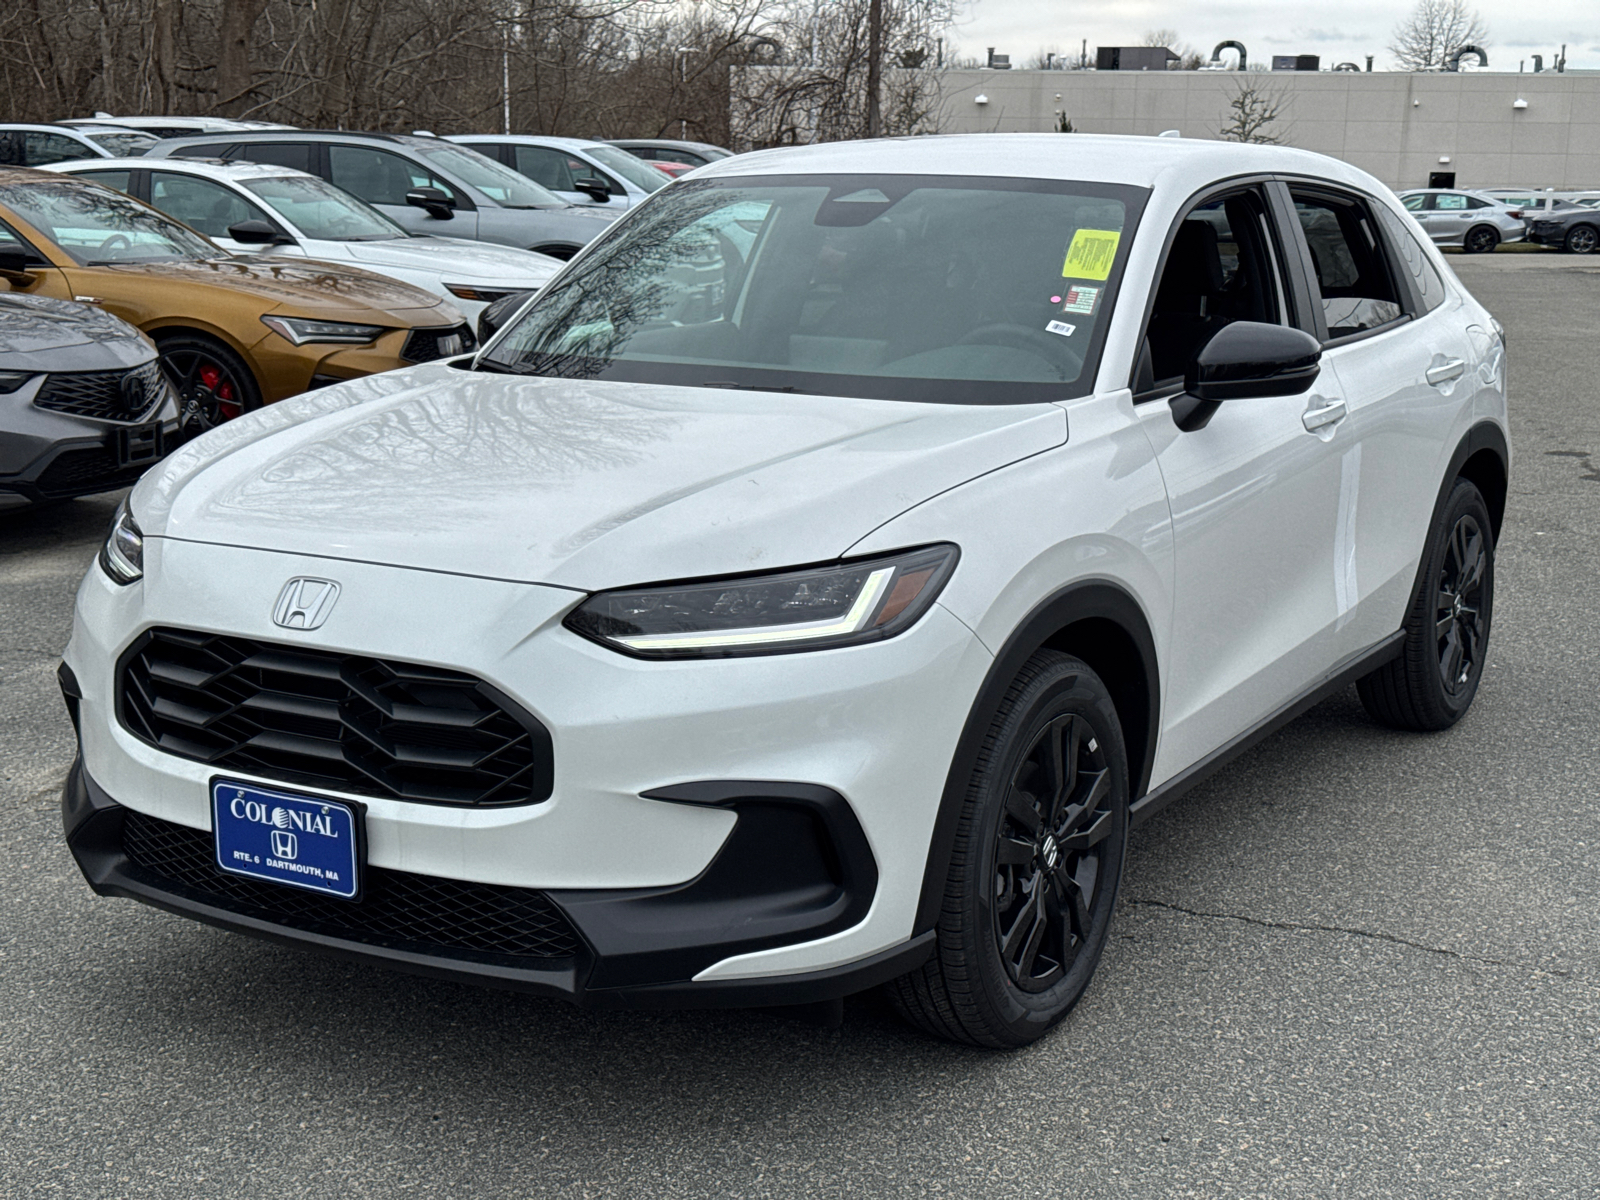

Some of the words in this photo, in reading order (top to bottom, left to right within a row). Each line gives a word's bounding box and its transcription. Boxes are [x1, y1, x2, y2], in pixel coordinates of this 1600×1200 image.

[230, 798, 338, 838] COLONIAL
[233, 850, 253, 863] RTE.
[254, 855, 260, 864] 6
[266, 858, 324, 878] DARTMOUTH,
[325, 869, 339, 881] MA
